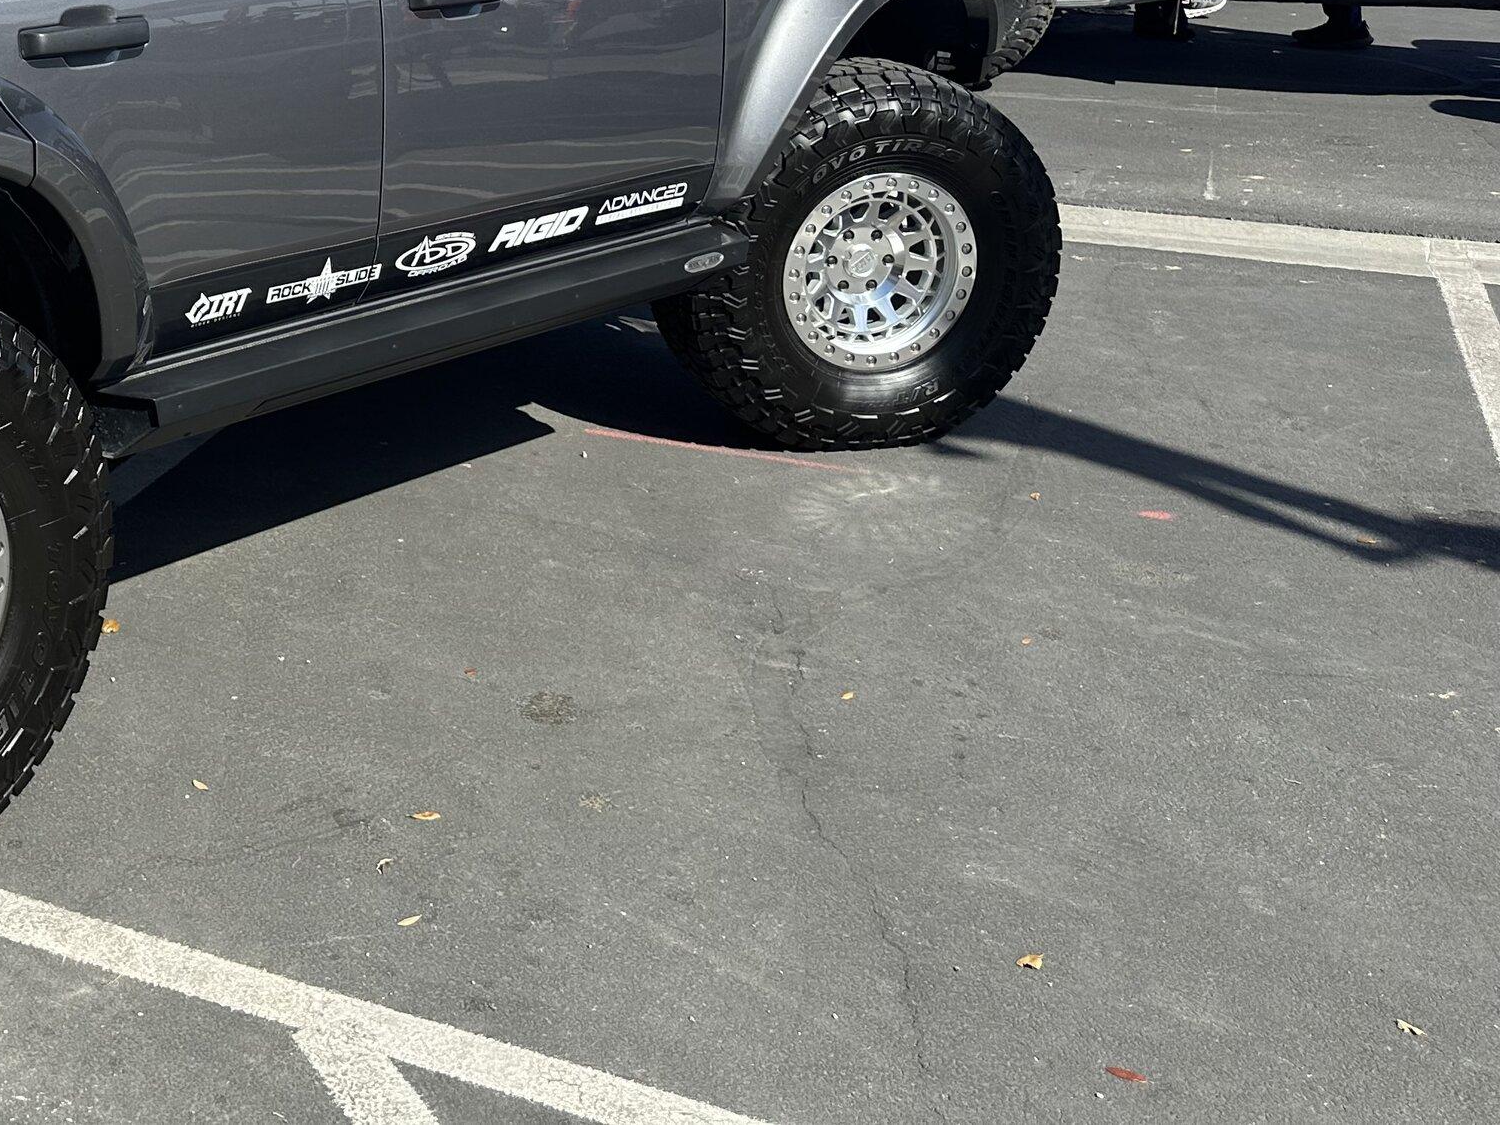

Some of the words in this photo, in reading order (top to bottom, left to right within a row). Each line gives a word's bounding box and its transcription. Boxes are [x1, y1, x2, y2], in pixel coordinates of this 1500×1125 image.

[598, 182, 688, 214] ADVANCED
[488, 206, 589, 253] RIGID
[270, 281, 312, 301] ROCK
[335, 265, 378, 286] SLIDE
[407, 253, 468, 278] OFFROAD
[185, 288, 252, 324] DIRT
